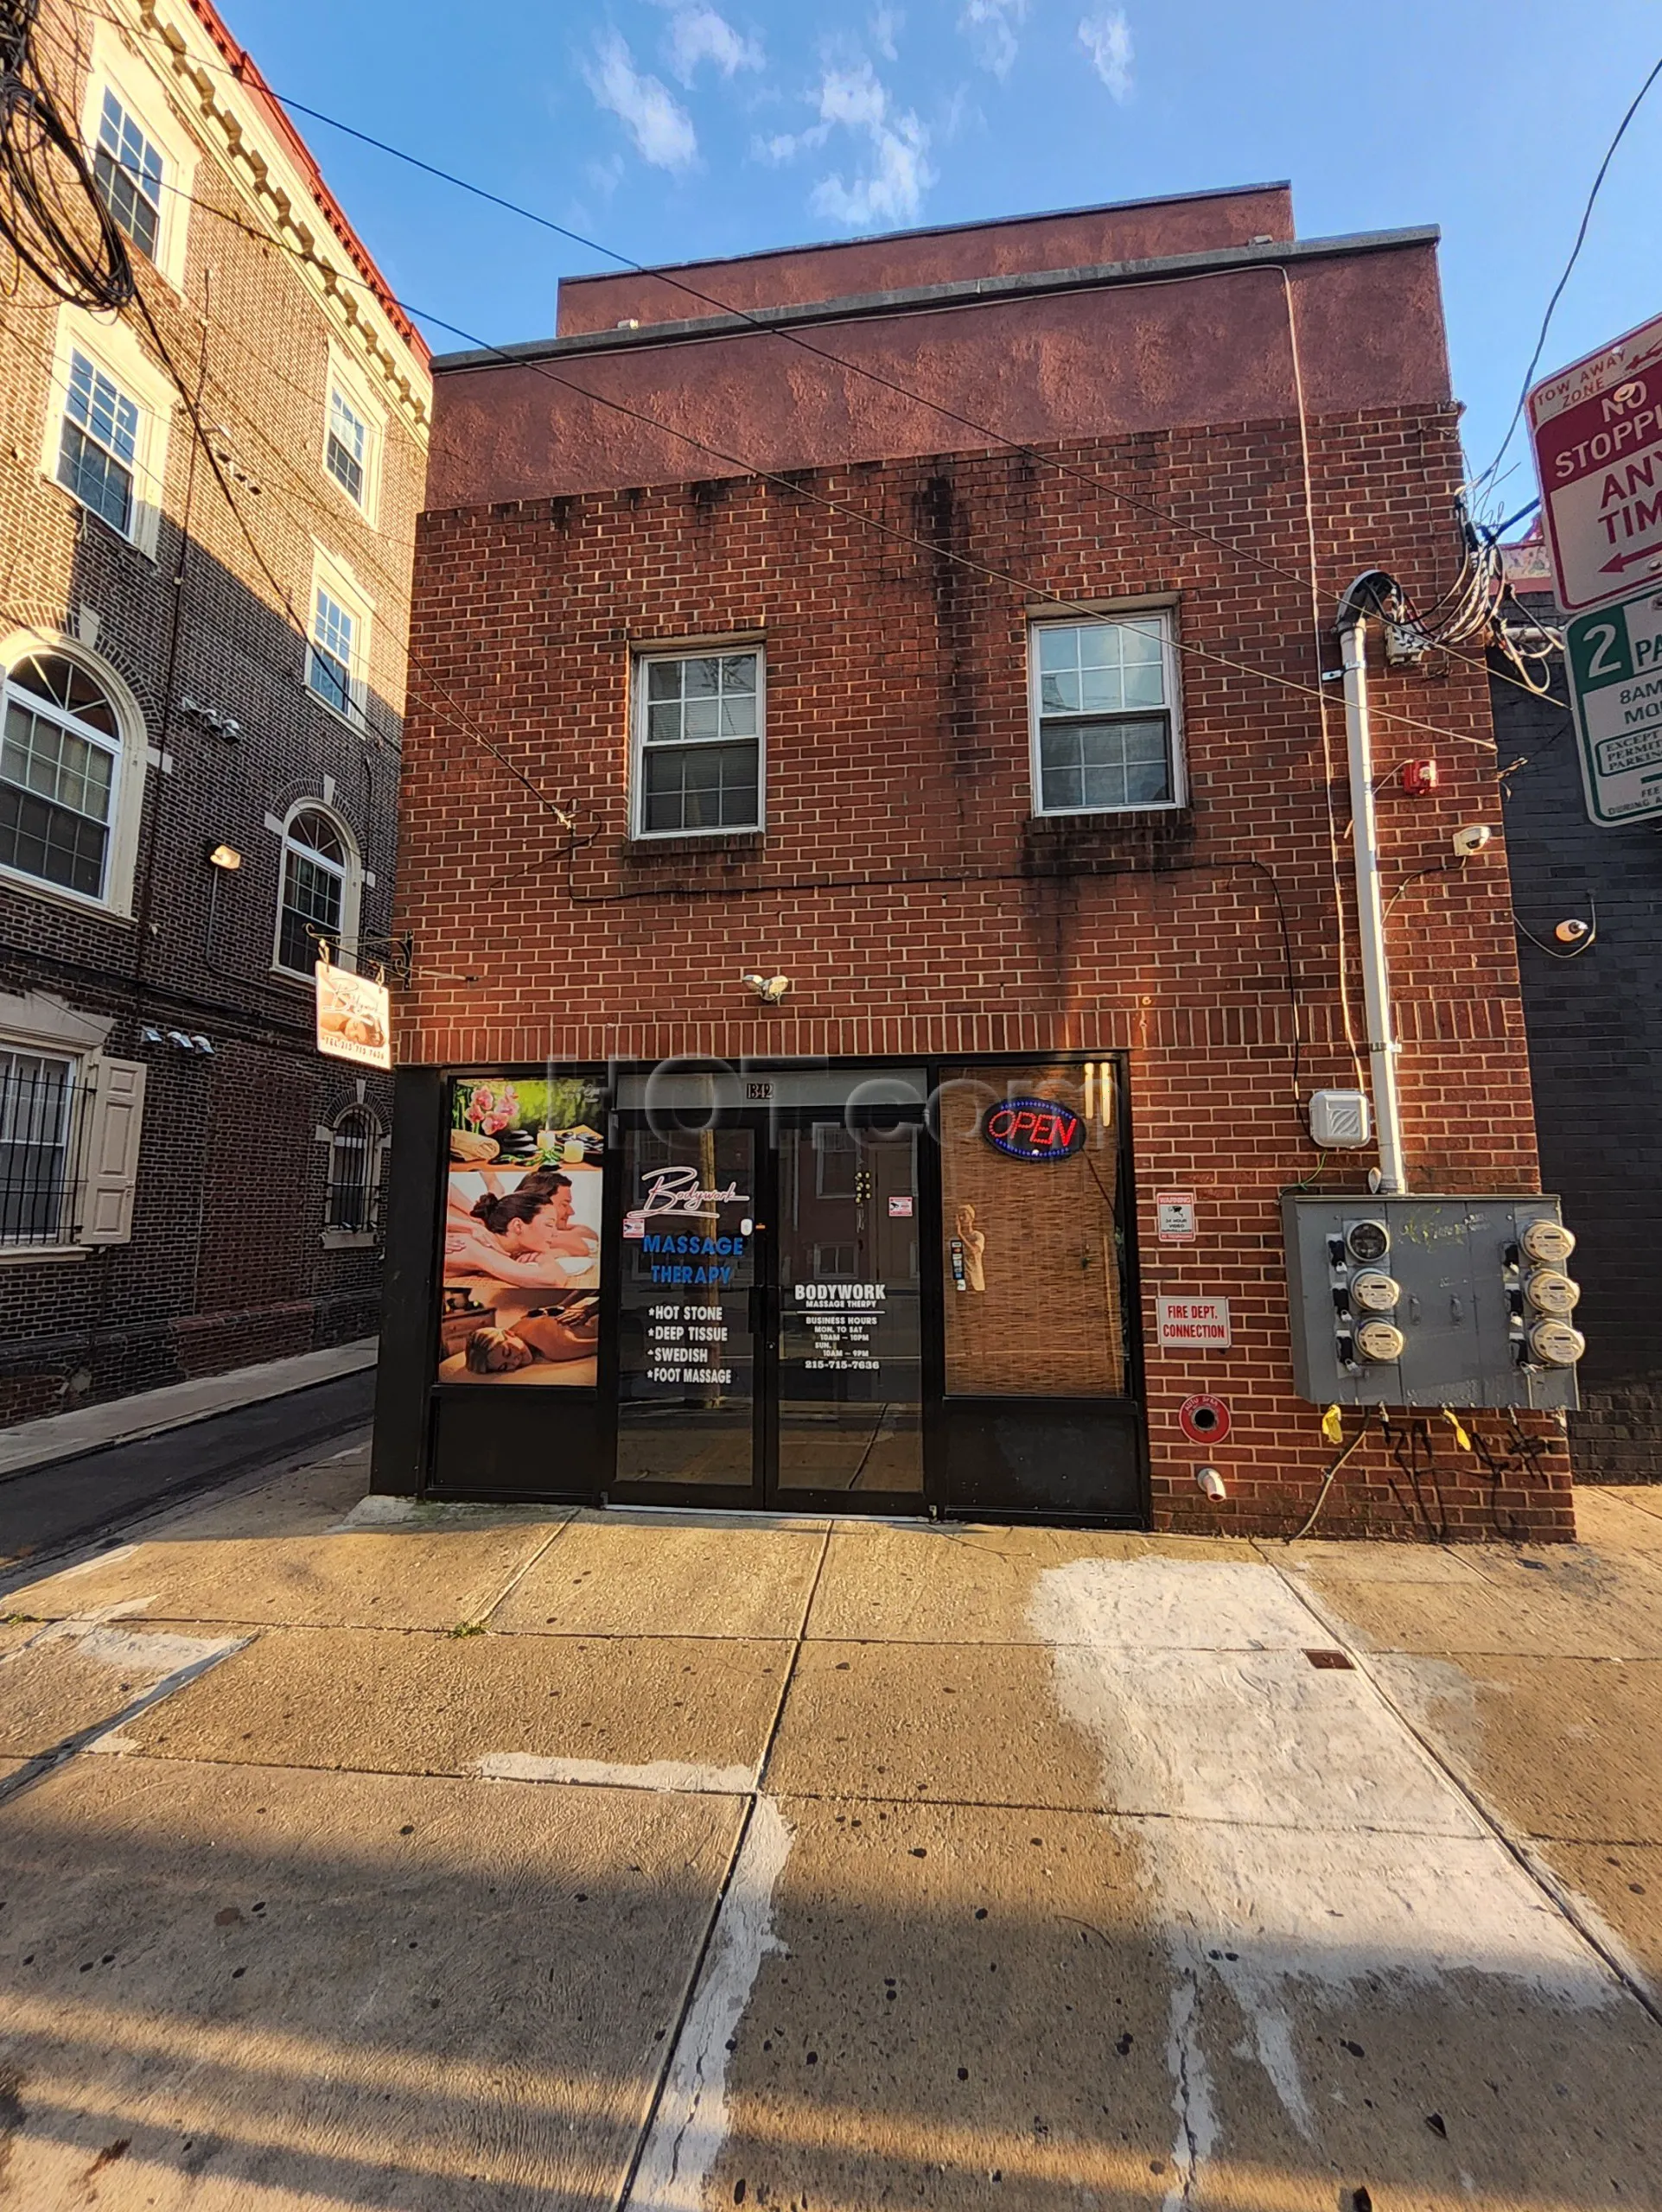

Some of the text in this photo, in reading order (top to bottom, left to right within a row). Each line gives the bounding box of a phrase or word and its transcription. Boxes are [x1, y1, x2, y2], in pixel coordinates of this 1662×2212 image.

[1537, 348, 1626, 406] TOW AWAY
[1563, 377, 1605, 410] ZONE
[1602, 380, 1646, 423] NO
[1582, 624, 1621, 678] 2
[1624, 699, 1662, 724] MO
[1606, 730, 1659, 753] EXCEPT
[1608, 741, 1662, 762] PERMIT
[1608, 751, 1662, 772] PARKIN
[1641, 786, 1660, 798] FEE
[989, 1109, 1077, 1147] OPEN
[627, 1166, 750, 1218] Bodywork
[643, 1235, 743, 1255] MASSAGE
[651, 1265, 732, 1285] THERAPY
[795, 1284, 886, 1300] BODYWORK
[655, 1306, 723, 1320] HOT STONE
[1168, 1305, 1218, 1319] FIRE DEPT.
[655, 1325, 728, 1341] DEEP TISSUE
[1163, 1324, 1225, 1338] CONNECTION
[654, 1348, 708, 1363] SWEDISH
[654, 1368, 731, 1383] FOOT MASSAGE
